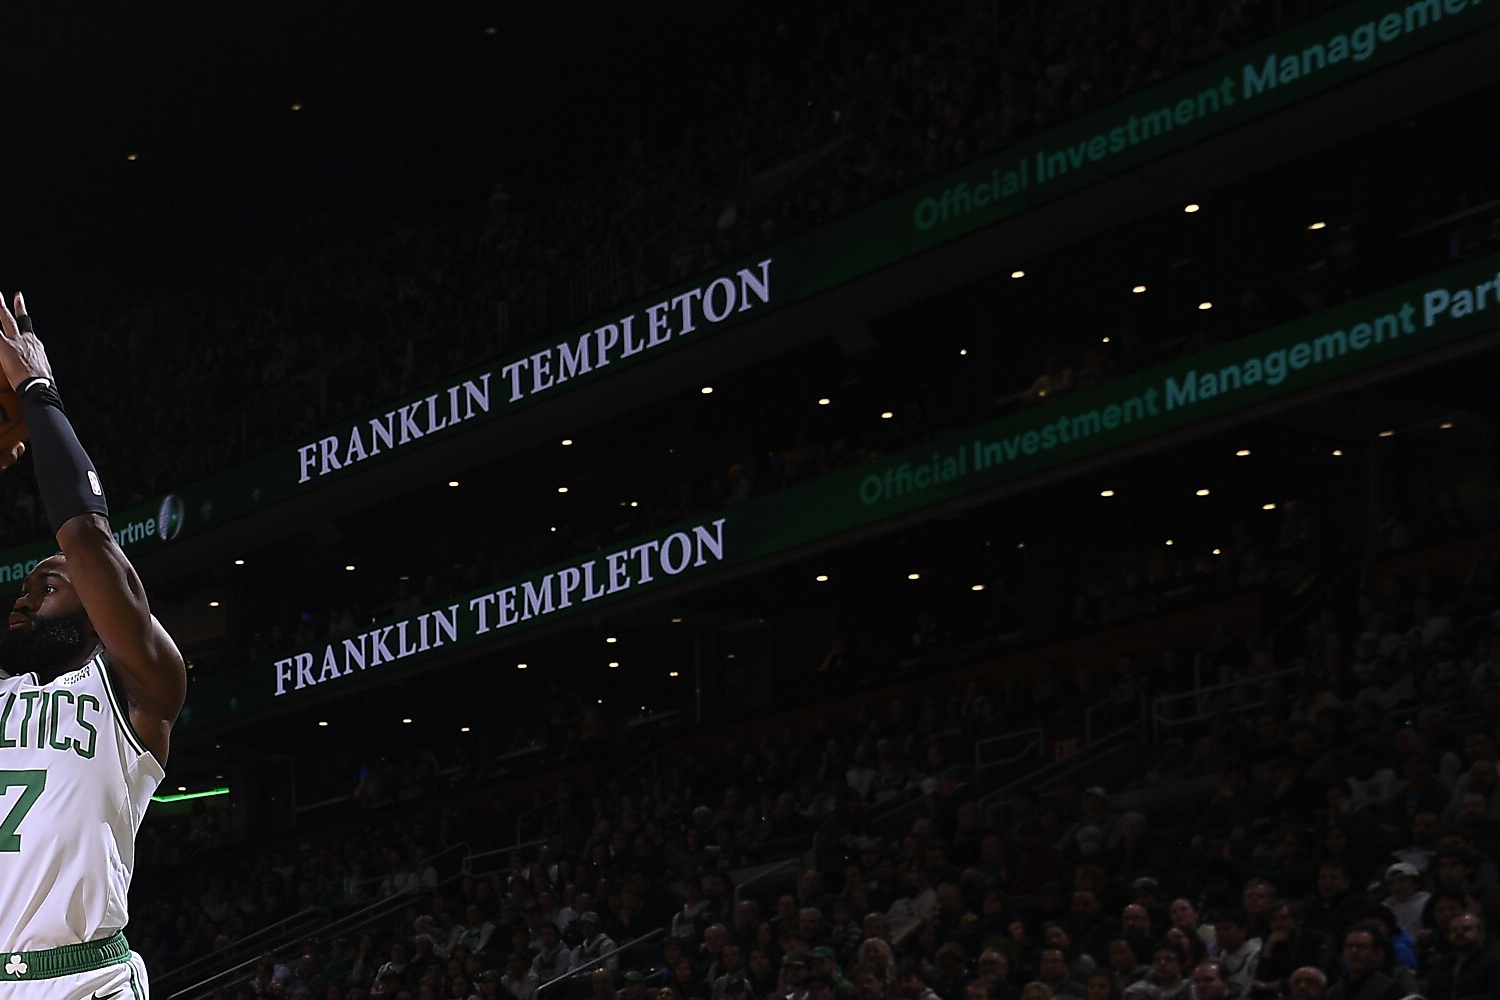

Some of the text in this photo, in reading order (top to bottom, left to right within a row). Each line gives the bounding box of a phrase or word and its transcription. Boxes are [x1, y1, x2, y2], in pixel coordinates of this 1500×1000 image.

[914, 158, 1030, 231] Official
[1036, 74, 1236, 184] Investment
[297, 259, 772, 484] FRANKLIN TEMPLETON
[859, 446, 967, 506] Official
[973, 387, 1159, 472] Investment
[1164, 302, 1417, 412] Management
[274, 518, 726, 697] FRANKLIN TEMPLETON
